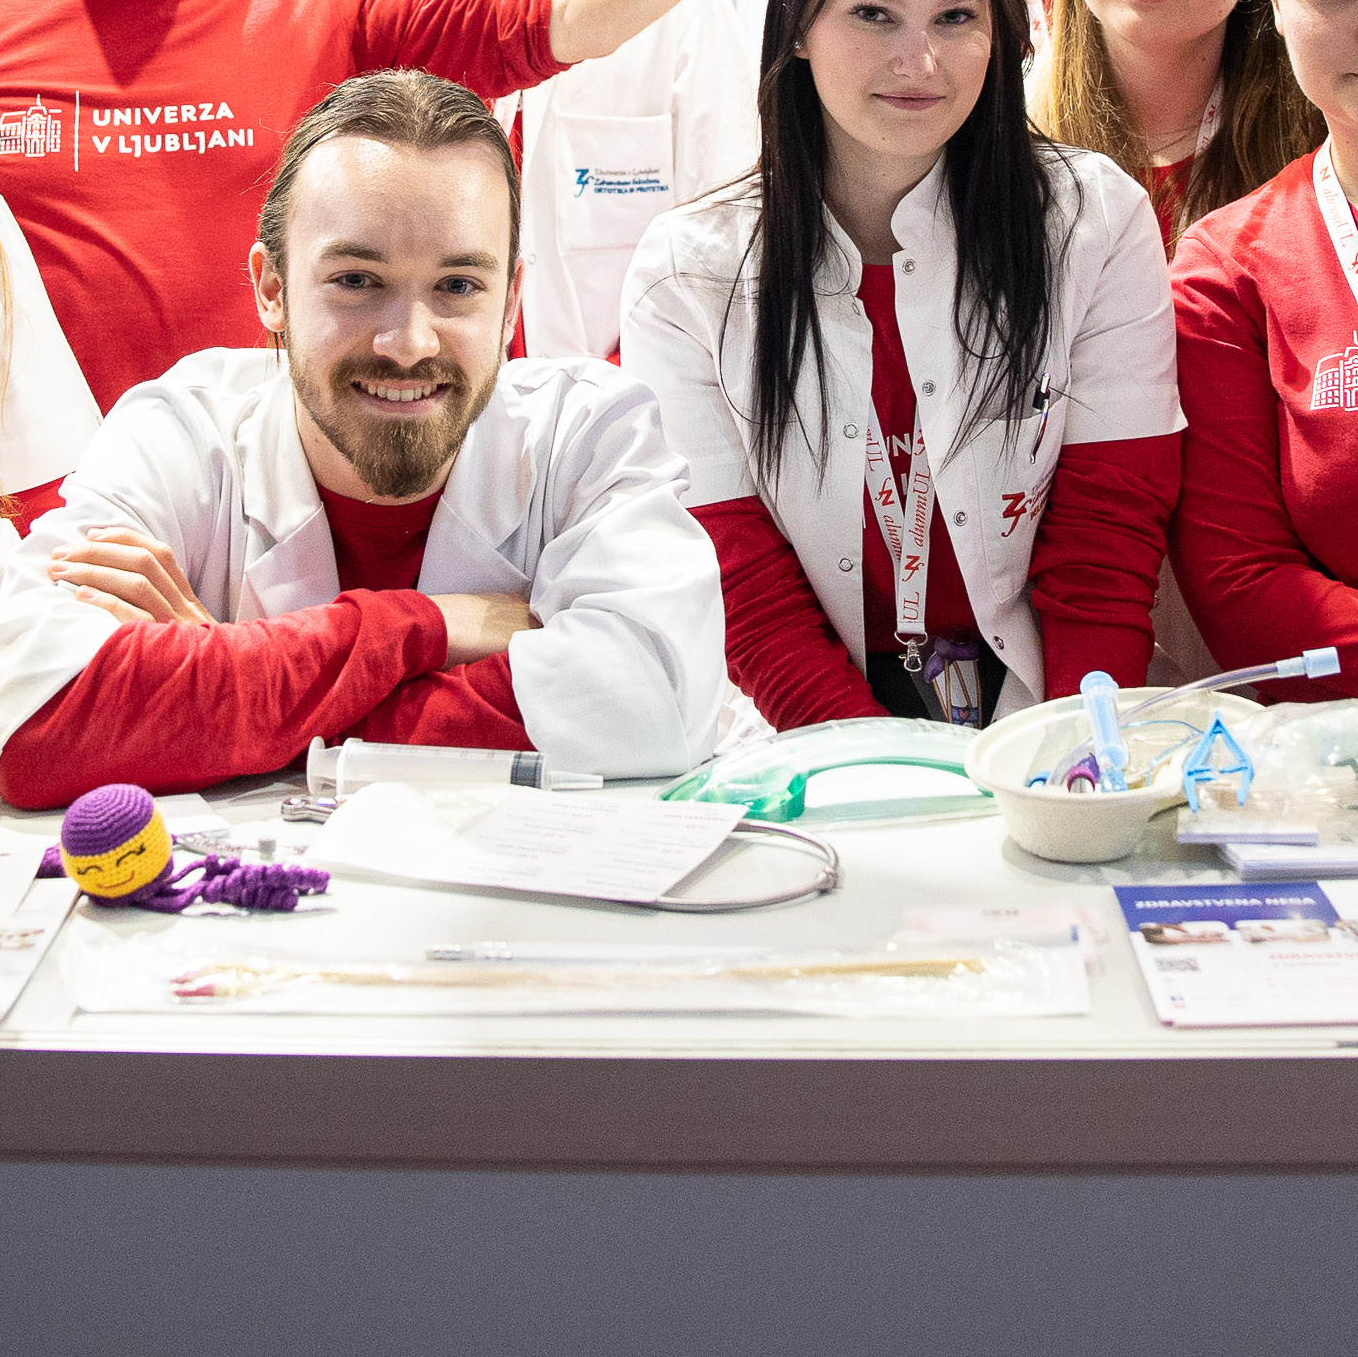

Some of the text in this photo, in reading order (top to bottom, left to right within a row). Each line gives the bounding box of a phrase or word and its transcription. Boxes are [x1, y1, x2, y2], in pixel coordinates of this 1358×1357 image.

[93, 102, 235, 127] UNIVERZA
[91, 128, 254, 158] V LJUBLJANI
[1134, 896, 1317, 910] ZDRAVSTVENA NEGA
